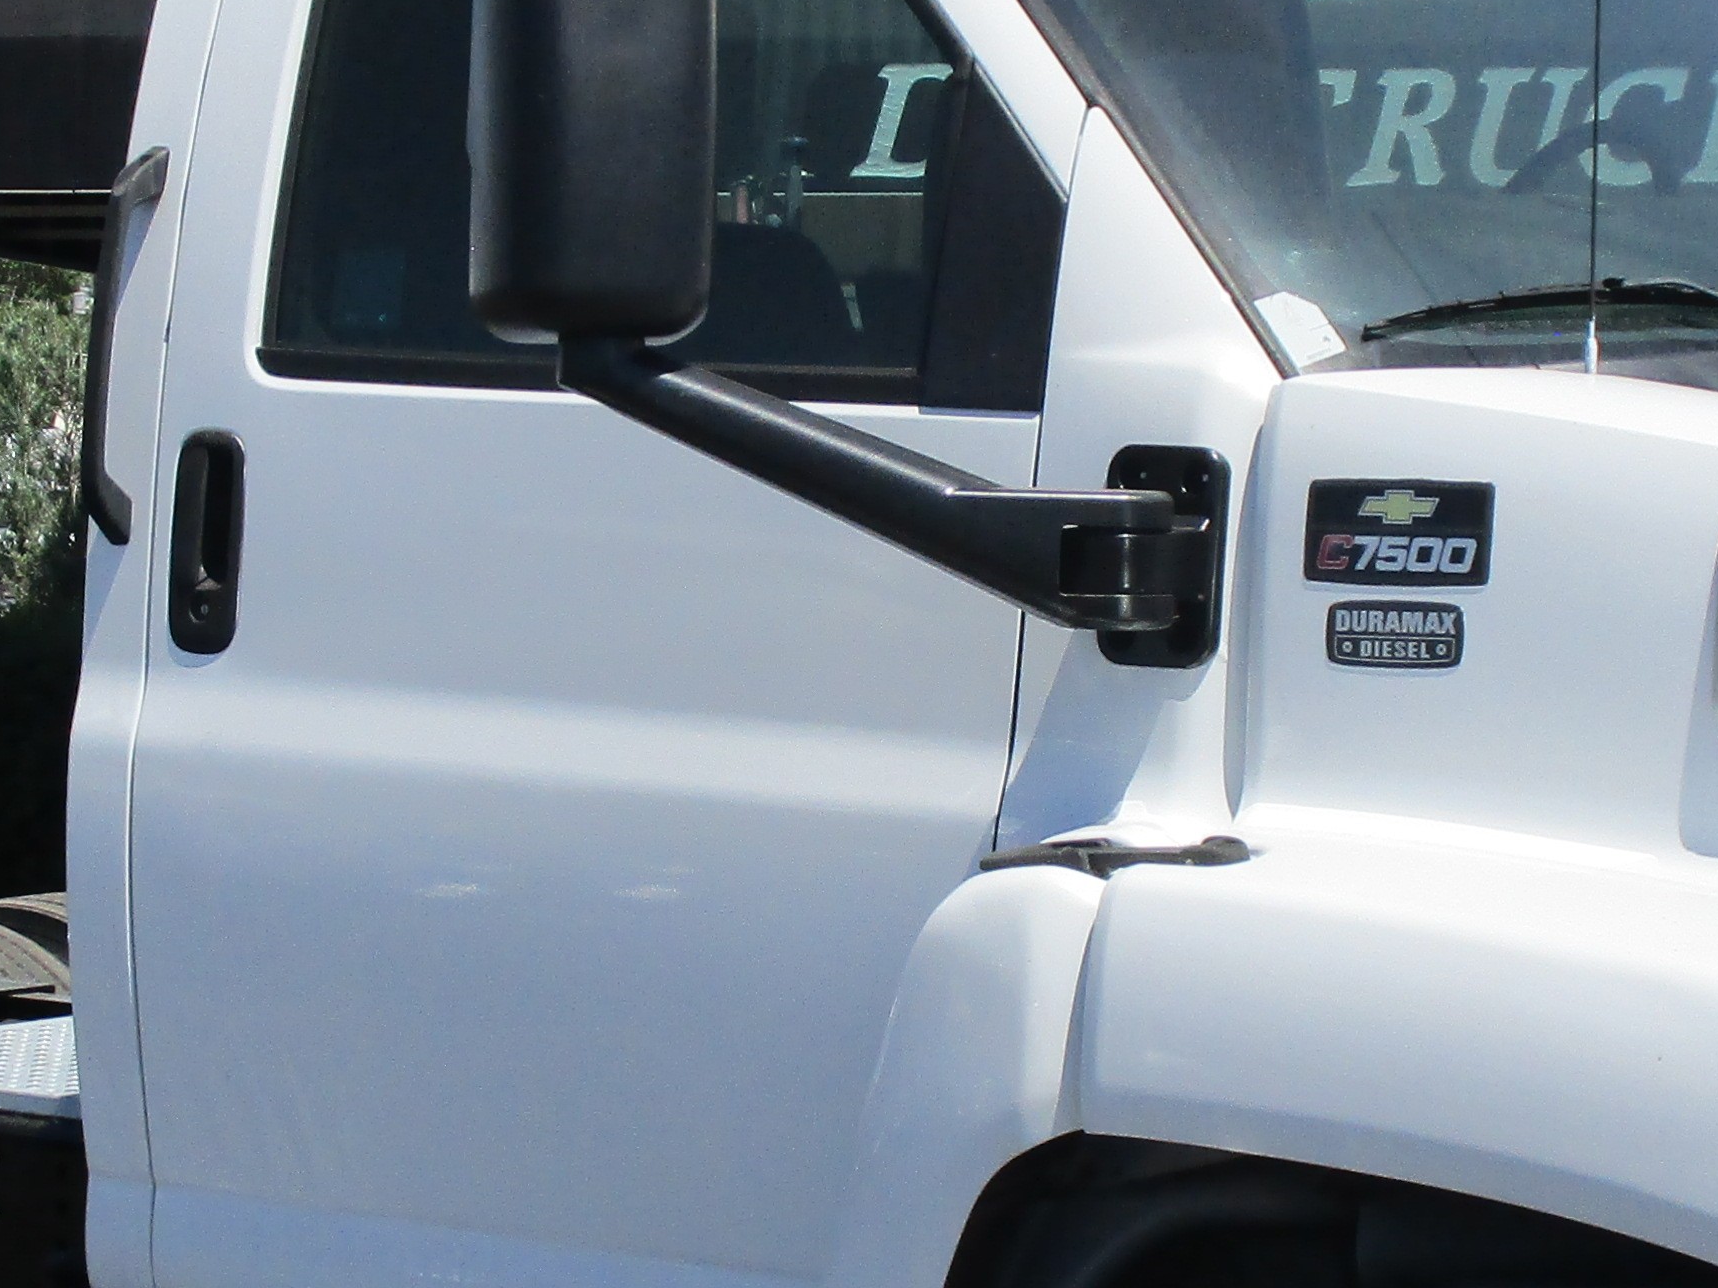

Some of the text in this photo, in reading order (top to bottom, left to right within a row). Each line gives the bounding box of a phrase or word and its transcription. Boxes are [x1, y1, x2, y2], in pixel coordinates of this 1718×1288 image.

[1315, 533, 1478, 575] C7500
[1335, 609, 1457, 635] DURAMAX
[1359, 639, 1431, 660] DIESEL
